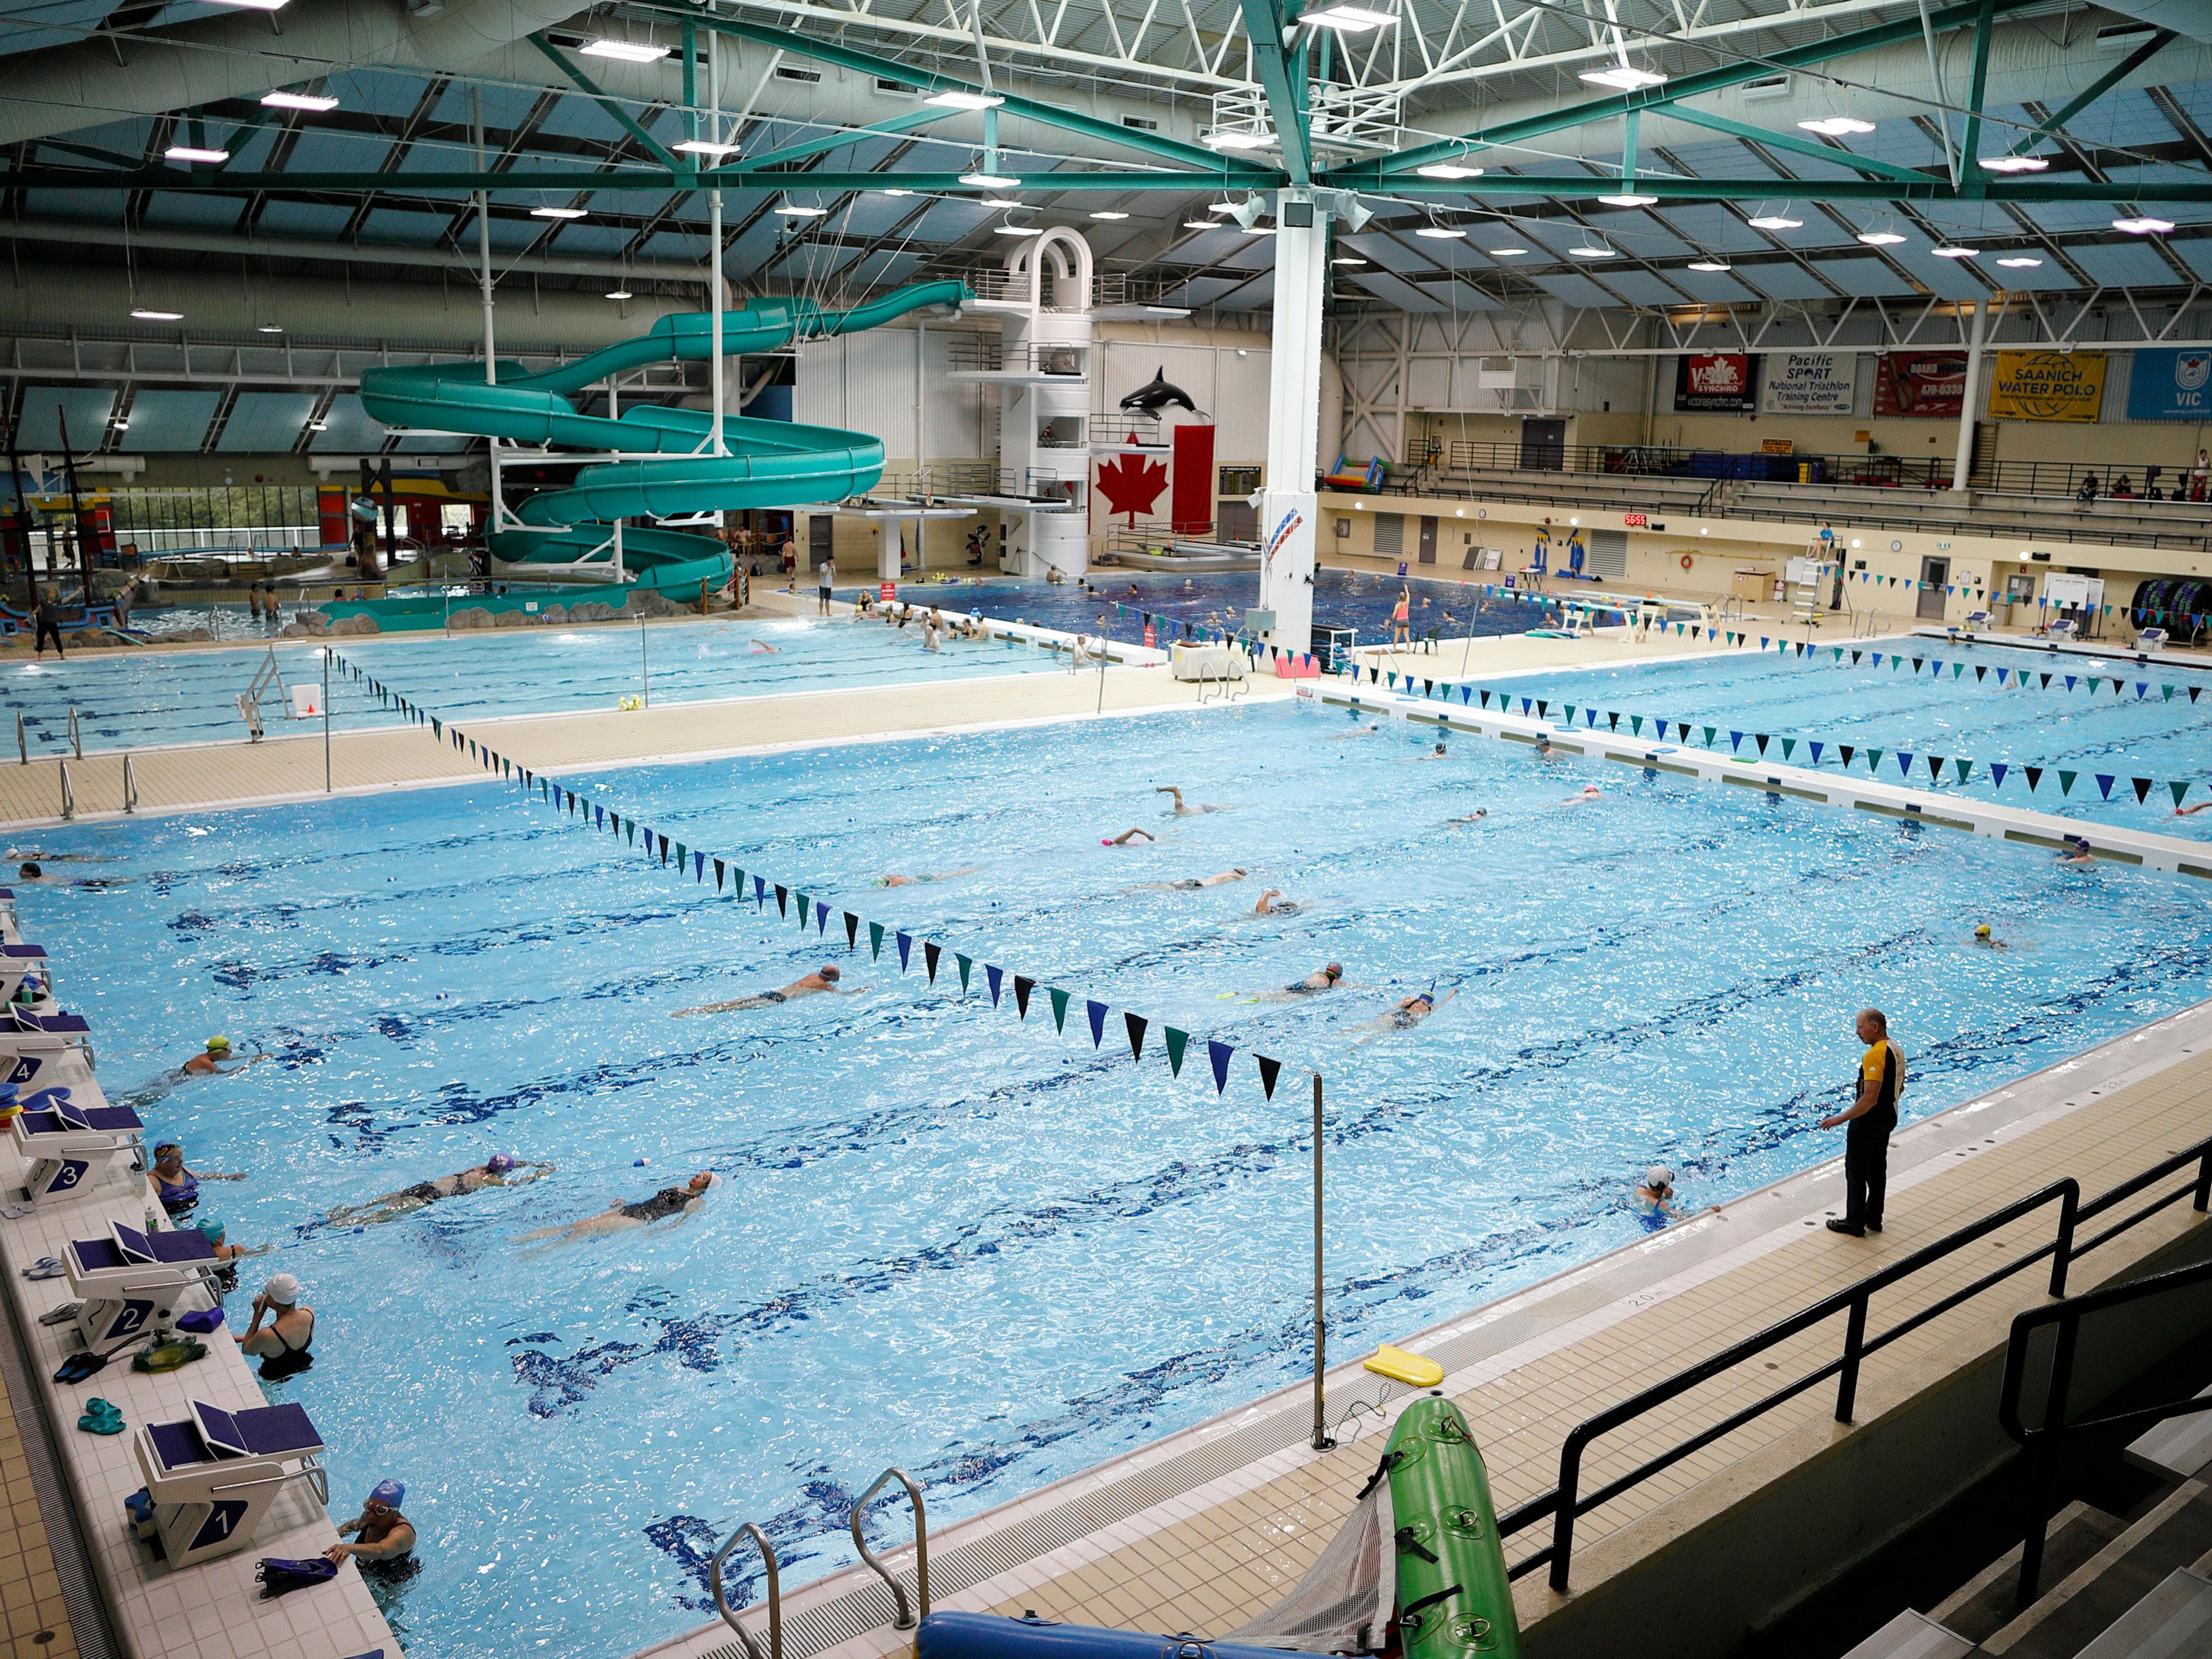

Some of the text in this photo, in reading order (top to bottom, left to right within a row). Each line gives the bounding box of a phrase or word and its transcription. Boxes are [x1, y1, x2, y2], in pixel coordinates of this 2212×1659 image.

[1788, 354, 1833, 366] Pacific
[1787, 368, 1832, 379] SPORT
[2015, 368, 2083, 382] SAANICH
[1769, 380, 1850, 391] National Triathlon
[1999, 380, 2095, 395] WATER POLO
[1687, 396, 1743, 409] victoriasynchro.com
[1777, 392, 1839, 403] Training Centre
[2176, 392, 2201, 406] VIC
[1625, 515, 1645, 525] 56:55
[17, 1063, 30, 1079] 4
[62, 1166, 77, 1185] 3
[1628, 1295, 1654, 1307] 20
[122, 1308, 139, 1330] 2
[215, 1510, 228, 1534] 1
